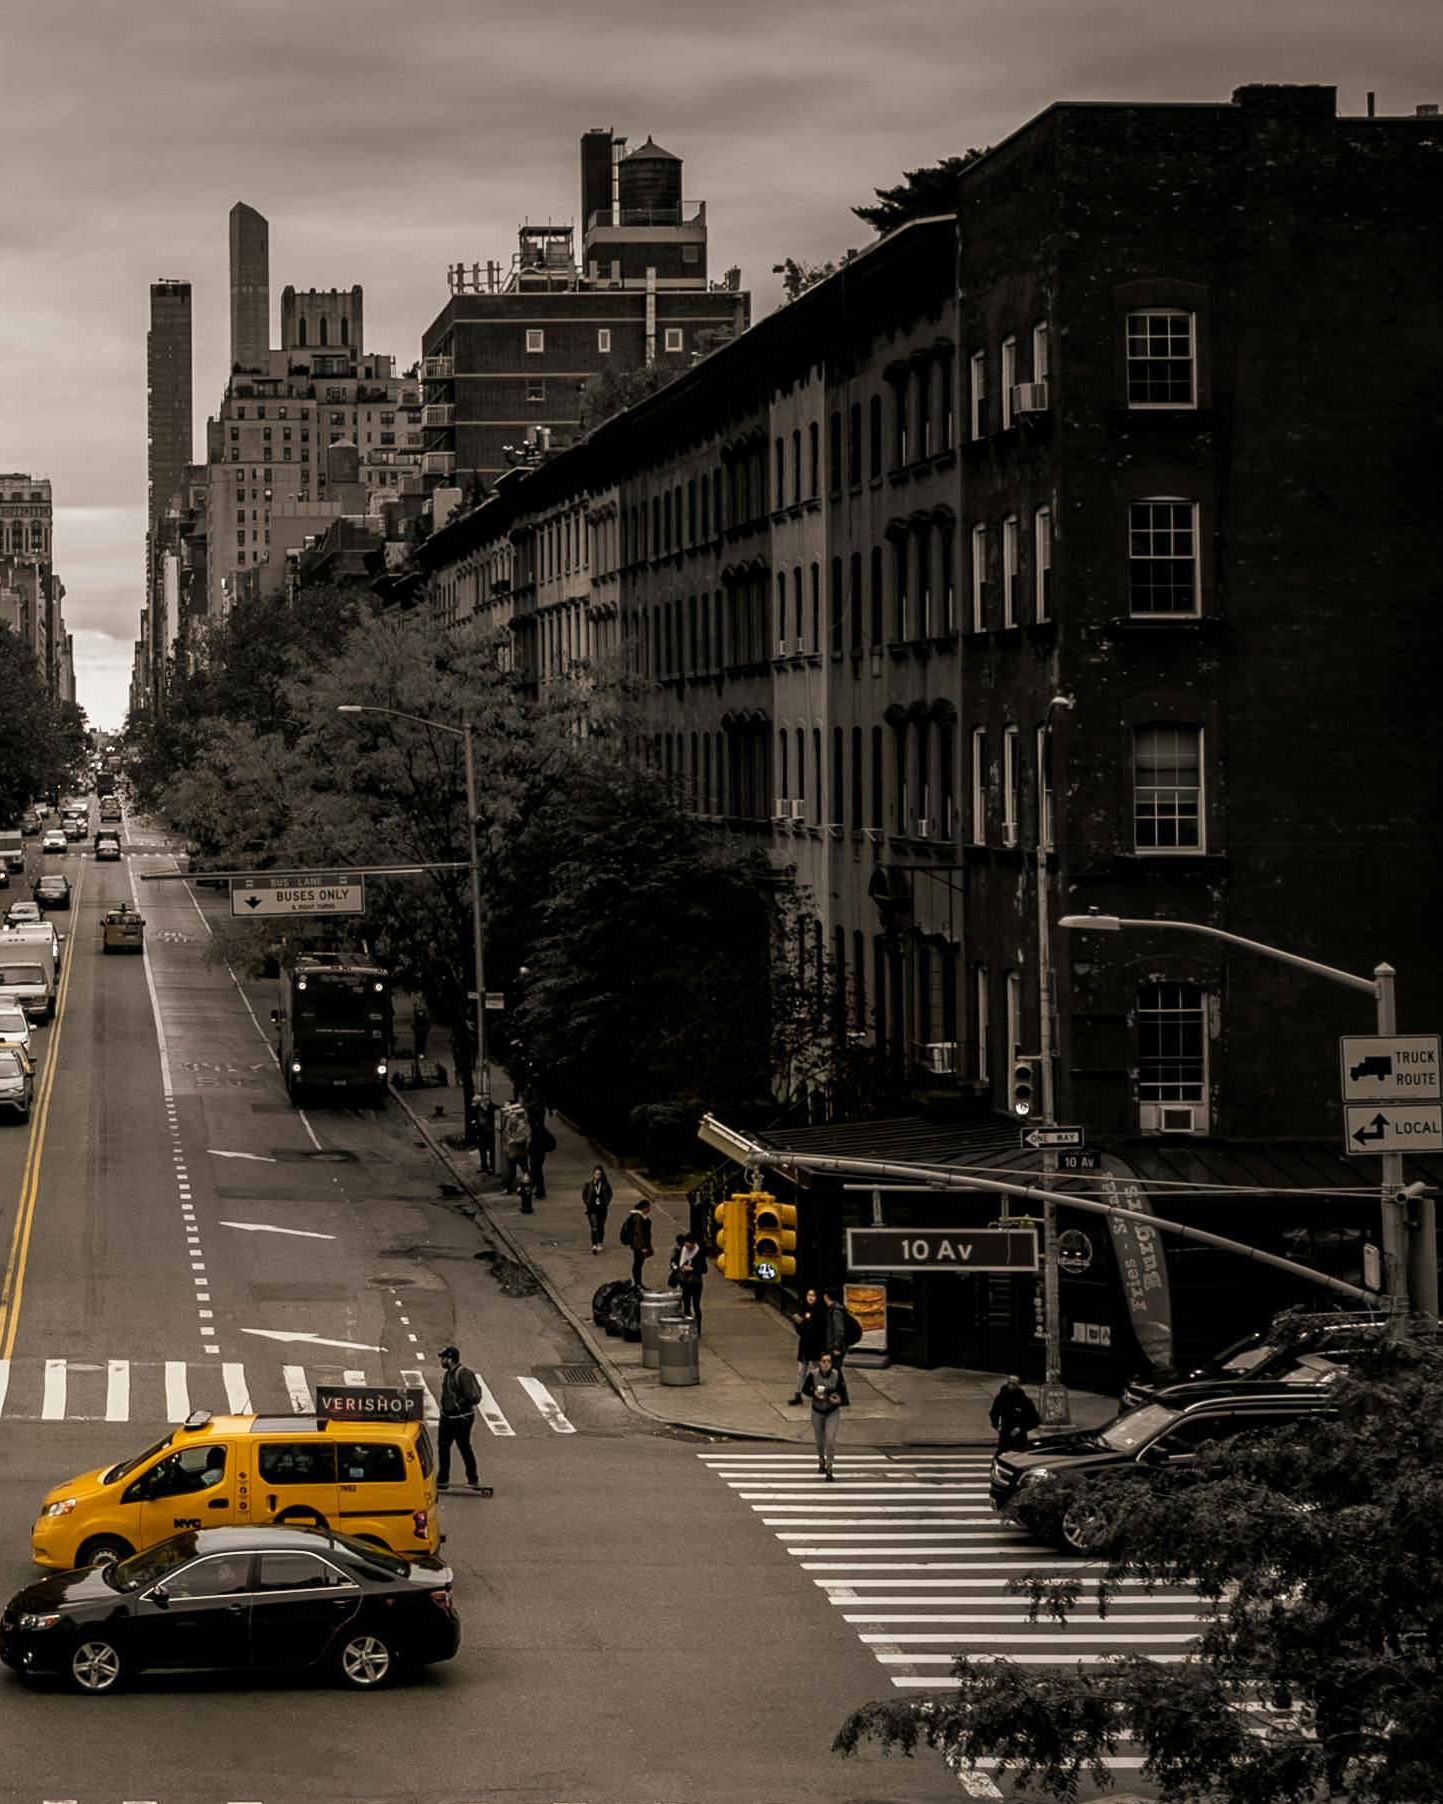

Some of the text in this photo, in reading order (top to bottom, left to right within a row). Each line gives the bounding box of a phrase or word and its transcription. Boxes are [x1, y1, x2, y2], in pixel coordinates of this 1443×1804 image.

[270, 877, 323, 887] BUS LANE
[276, 889, 349, 902] BUSES ONLY
[1395, 1051, 1435, 1063] TRUCK
[1397, 1073, 1436, 1086] ROUTE
[1395, 1122, 1440, 1134] LOCAL
[1031, 1134, 1075, 1143] ONE WAY
[1065, 1156, 1094, 1168] 10 Av
[1123, 1185, 1163, 1291] Burgrs
[901, 1239, 973, 1260] 10 Av
[1125, 1259, 1147, 1312] Fries
[322, 1397, 415, 1412] VERISHOP
[174, 1519, 201, 1529] NYC
